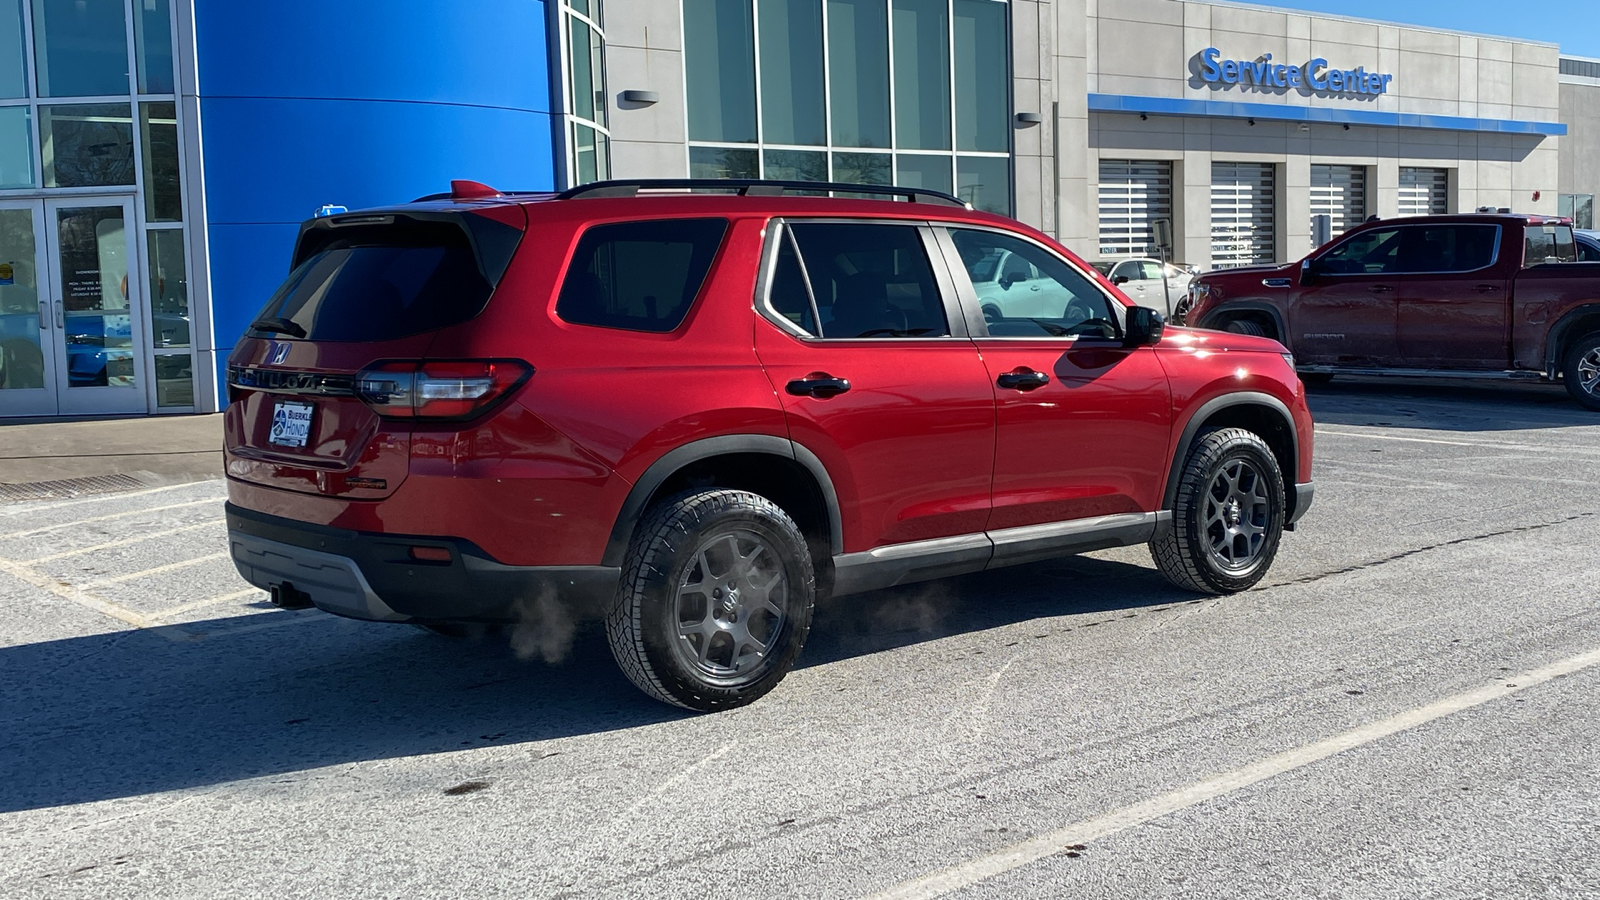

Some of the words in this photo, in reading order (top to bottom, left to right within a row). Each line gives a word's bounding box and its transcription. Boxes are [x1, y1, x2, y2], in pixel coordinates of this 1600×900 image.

[1202, 47, 1300, 88] Service
[1306, 57, 1393, 94] Center
[287, 409, 313, 421] BUERKLE
